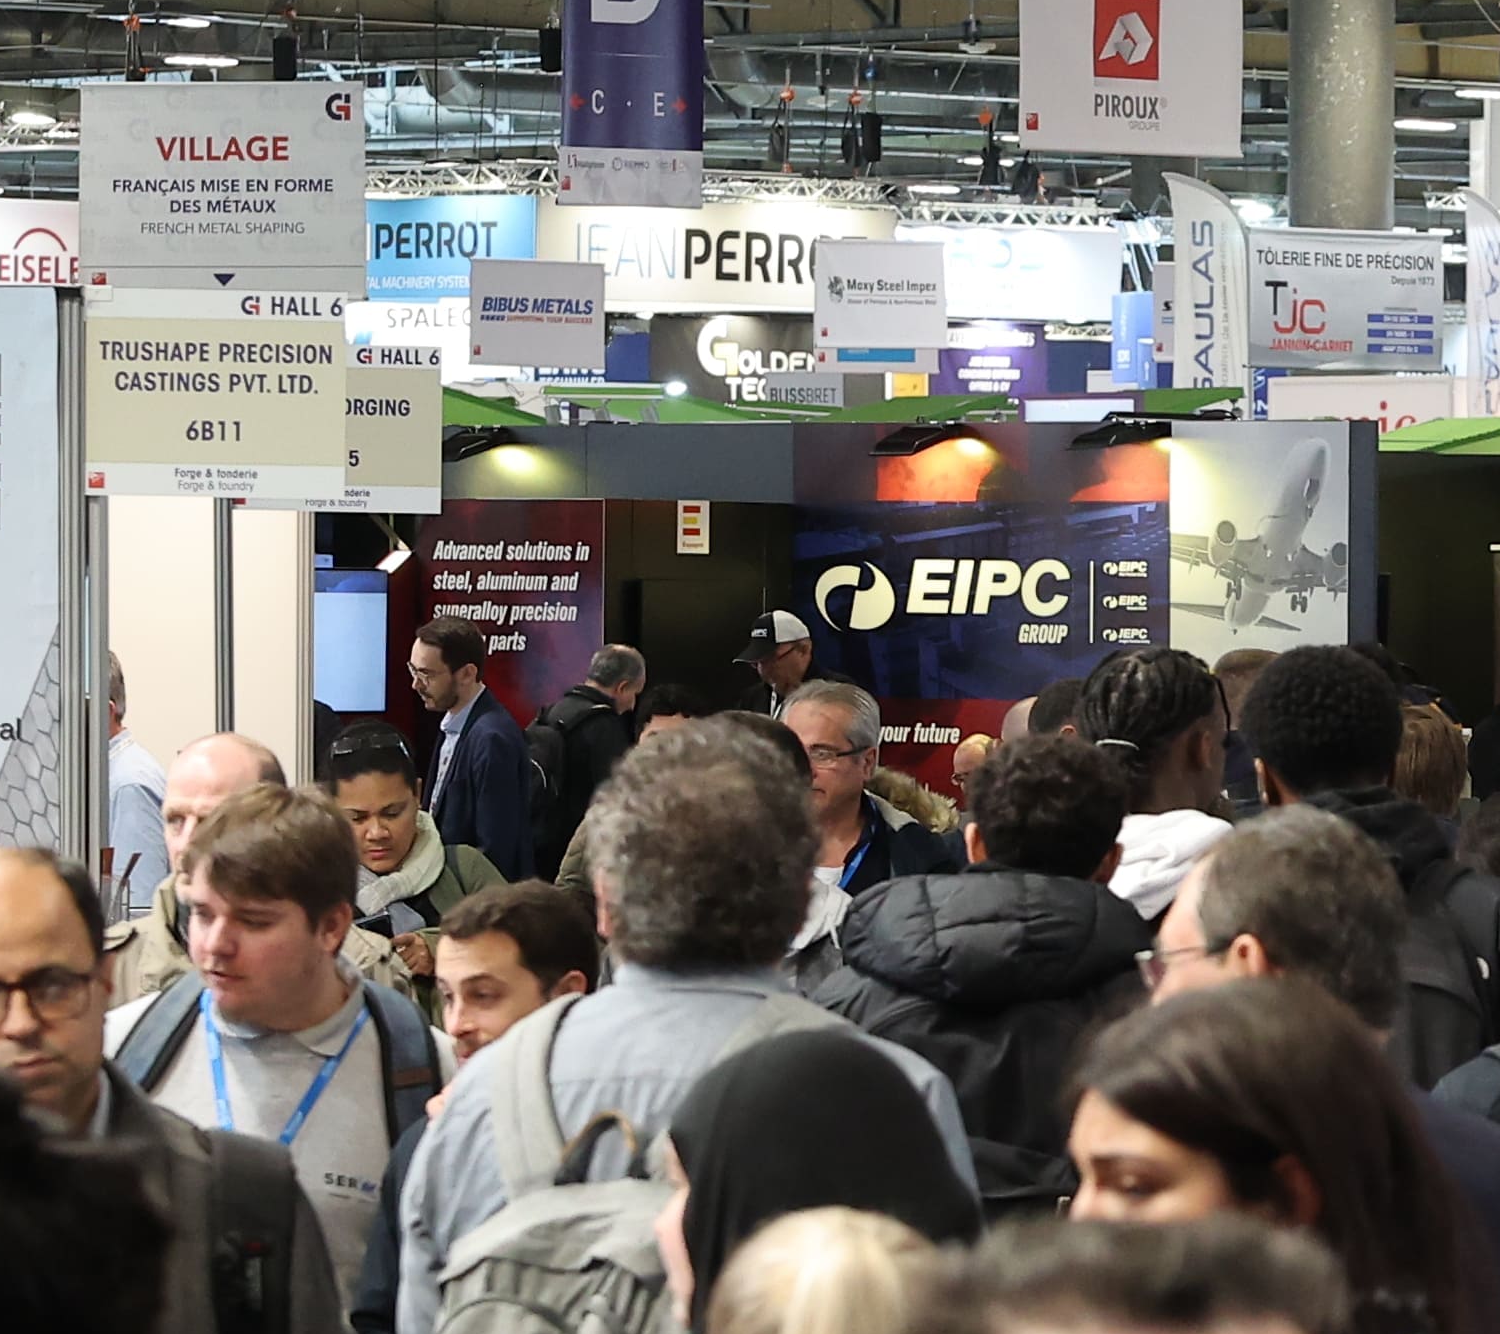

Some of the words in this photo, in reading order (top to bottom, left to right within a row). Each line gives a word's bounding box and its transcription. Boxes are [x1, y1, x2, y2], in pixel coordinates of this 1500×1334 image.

[591, 90, 604, 115] C
[654, 93, 664, 117] E
[1094, 92, 1159, 119] PIROUX
[156, 136, 289, 162] VILLAGE
[113, 179, 195, 195] FRANÇAIS
[201, 179, 243, 192] MISE
[249, 179, 269, 192] EN
[275, 179, 333, 193] FORME
[170, 200, 200, 213] DES
[207, 197, 276, 213] MÉTAUX
[141, 222, 194, 234] FRENCH
[198, 222, 241, 234] METAL
[246, 223, 305, 235] SHAPING
[375, 221, 497, 259] PERROT
[1257, 247, 1312, 266] TÔLERIE
[1315, 252, 1342, 268] FINE
[1346, 254, 1362, 268] DE
[1367, 251, 1434, 271] PRÉCISION
[381, 276, 435, 289] MACHINERY
[877, 279, 904, 291] Steel
[907, 280, 936, 294] Impex
[271, 298, 321, 316] HALL
[331, 298, 342, 316] 6
[482, 297, 528, 313] BIBUS
[532, 298, 593, 316] METALS
[100, 341, 209, 362] TRUSHAPE
[219, 344, 332, 364] PRECISION
[381, 349, 425, 365] HALL
[429, 351, 439, 364] 6
[115, 371, 220, 392] CASTINGS
[229, 374, 271, 393] PVT.
[278, 375, 318, 394] LTD.
[186, 421, 241, 441] 6B11
[349, 451, 359, 466] 5
[175, 468, 202, 481] Forge
[206, 469, 213, 478] &
[217, 468, 258, 479] fonderie
[178, 480, 203, 491] Forge
[207, 481, 215, 491] &
[219, 481, 254, 492] foundry
[433, 540, 503, 562] Advanced
[506, 542, 571, 562] solutions
[575, 542, 590, 562] in
[433, 572, 472, 593] steel,
[477, 572, 548, 591] aluminum
[552, 572, 579, 591] and
[906, 558, 1072, 616] EIPC
[433, 602, 507, 625] superalloy
[510, 604, 578, 624] precision
[489, 632, 526, 652] parts
[1018, 624, 1068, 644] GROUP
[879, 725, 911, 745] your
[915, 722, 960, 744] future
